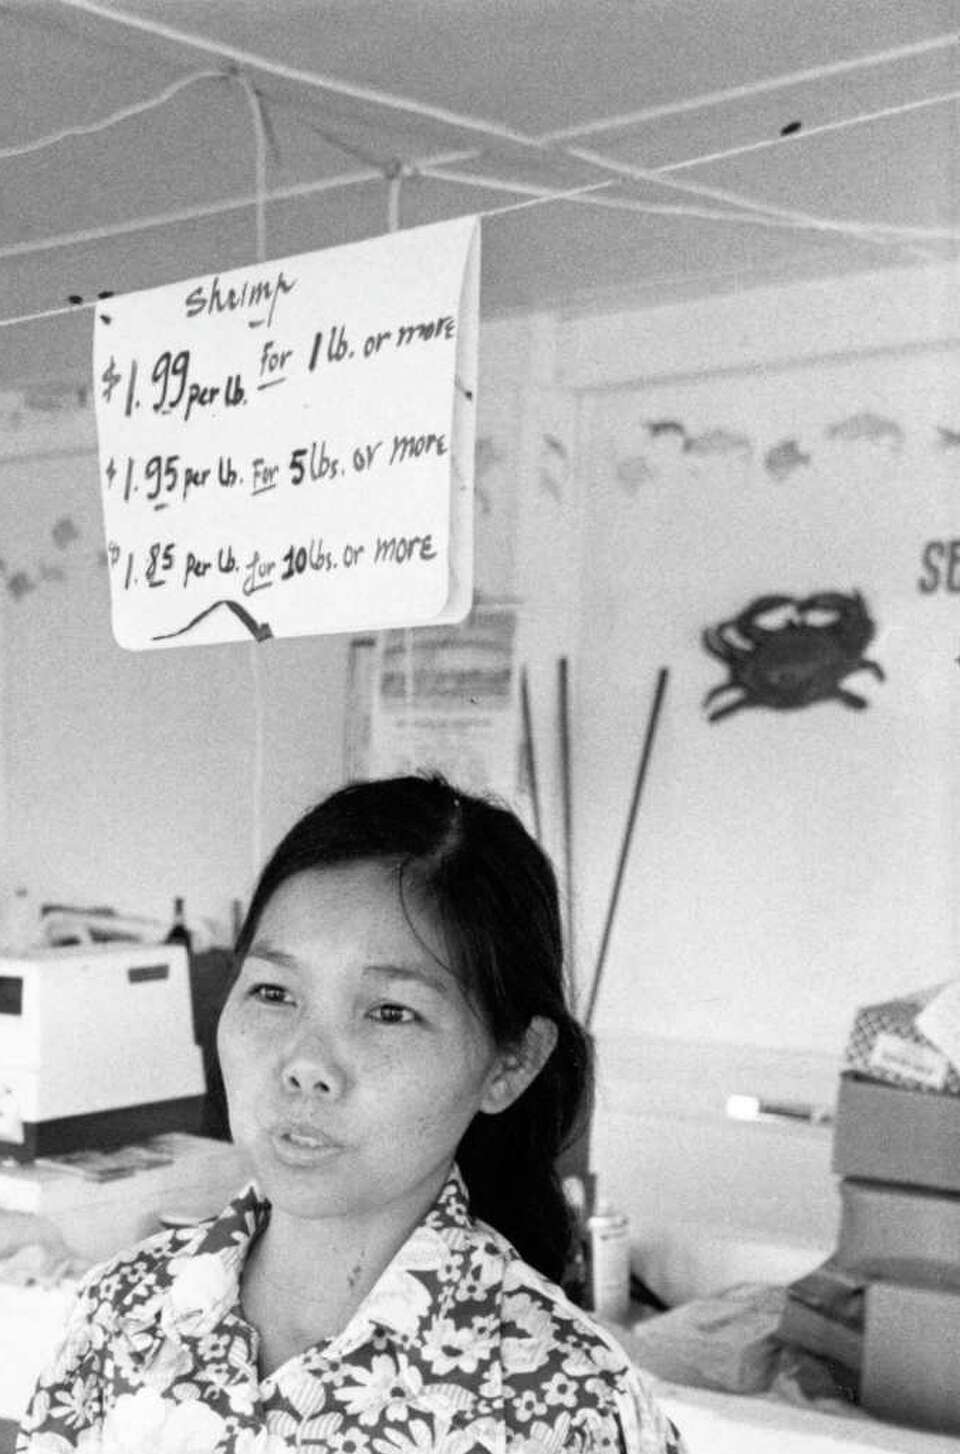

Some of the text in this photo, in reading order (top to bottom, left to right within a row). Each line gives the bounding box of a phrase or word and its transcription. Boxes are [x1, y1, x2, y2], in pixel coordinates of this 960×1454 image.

[308, 332, 323, 372] 1
[364, 332, 392, 359] or
[395, 315, 456, 348] more
[353, 441, 383, 472] or
[390, 433, 449, 467] more
[343, 545, 365, 569] or
[374, 533, 439, 565] more
